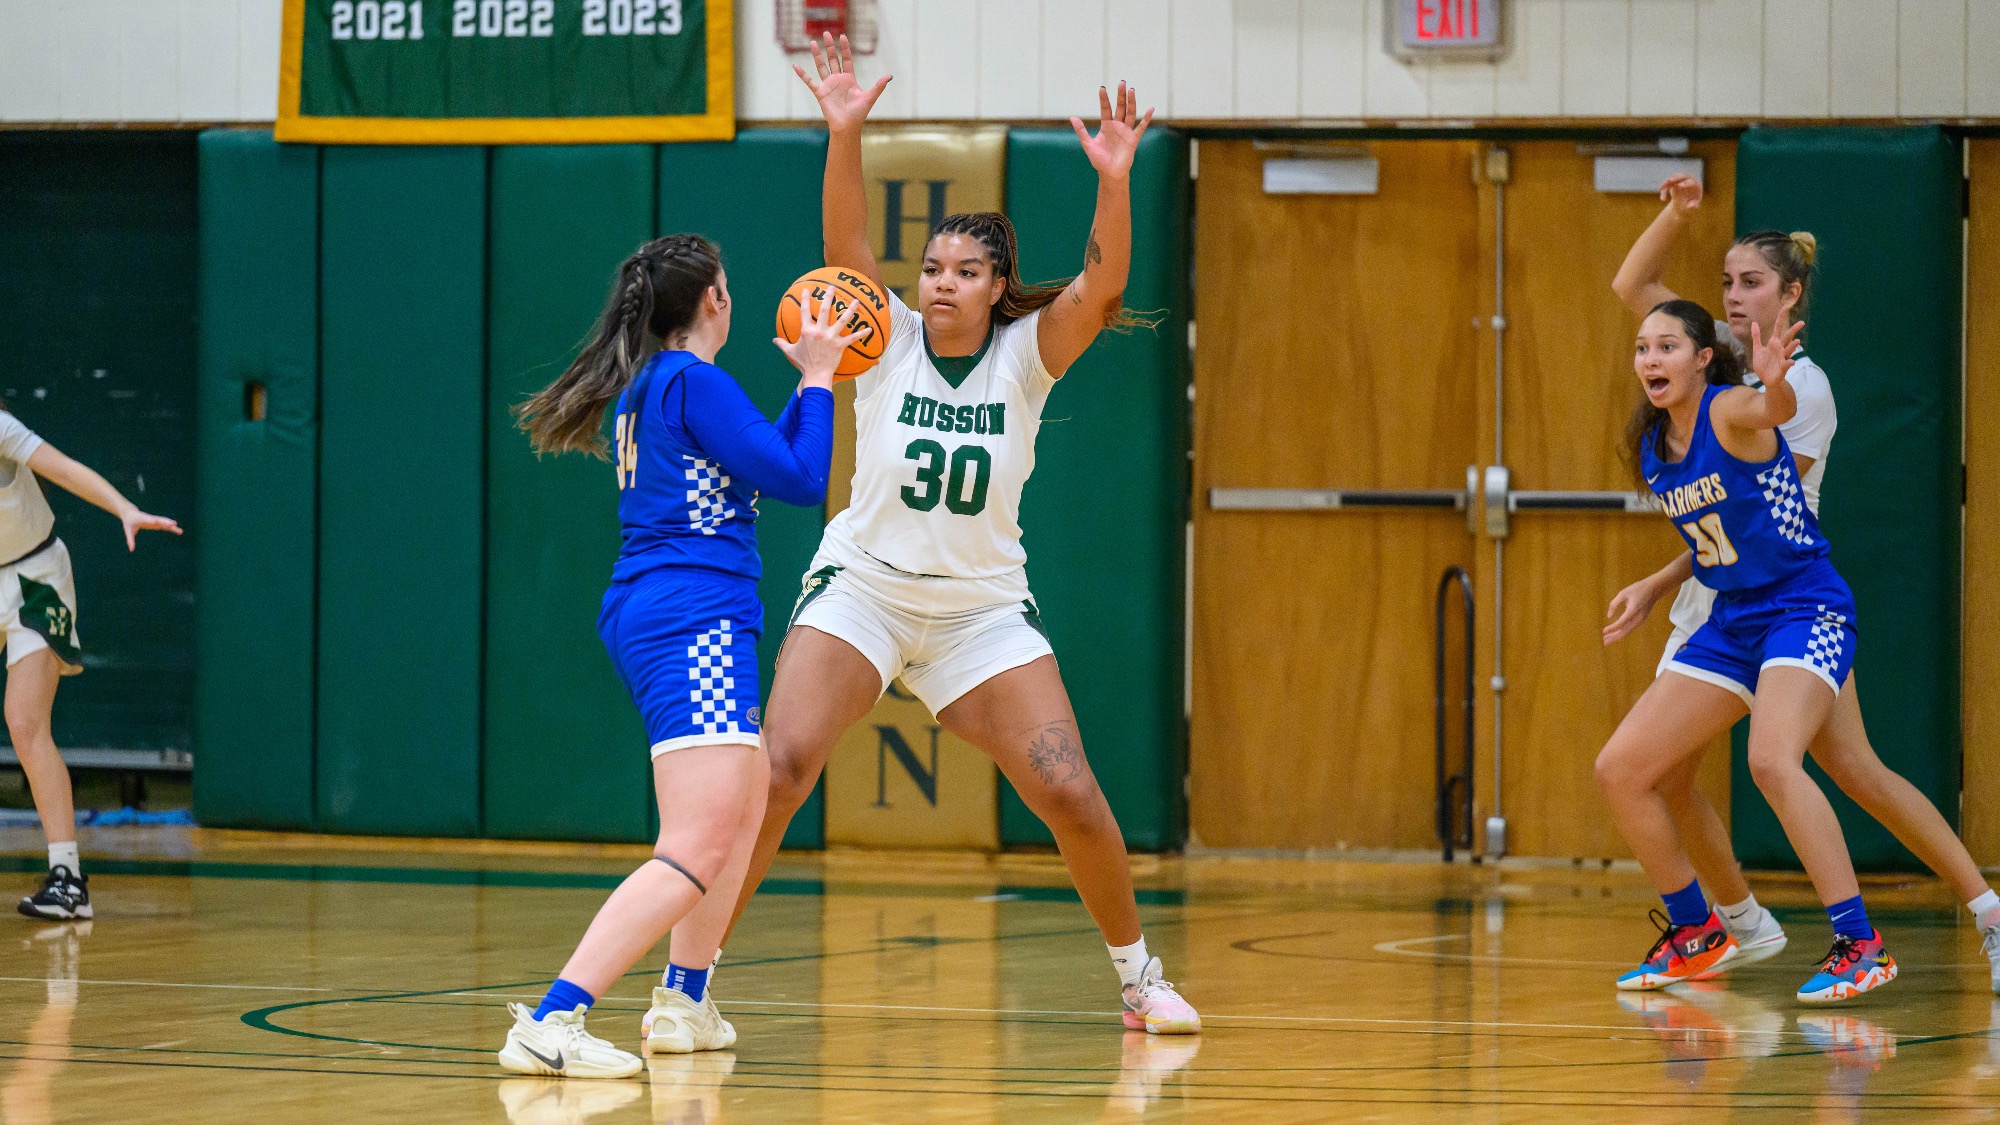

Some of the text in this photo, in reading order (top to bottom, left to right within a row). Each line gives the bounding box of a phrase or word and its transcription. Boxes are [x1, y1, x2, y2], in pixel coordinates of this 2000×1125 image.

[331, 0, 683, 40] 2021 2022 2023
[837, 271, 885, 311] NCAA
[897, 392, 1006, 435] HUSSON
[616, 412, 638, 490] 34
[901, 438, 992, 516] 30
[1685, 938, 1699, 954] 13
